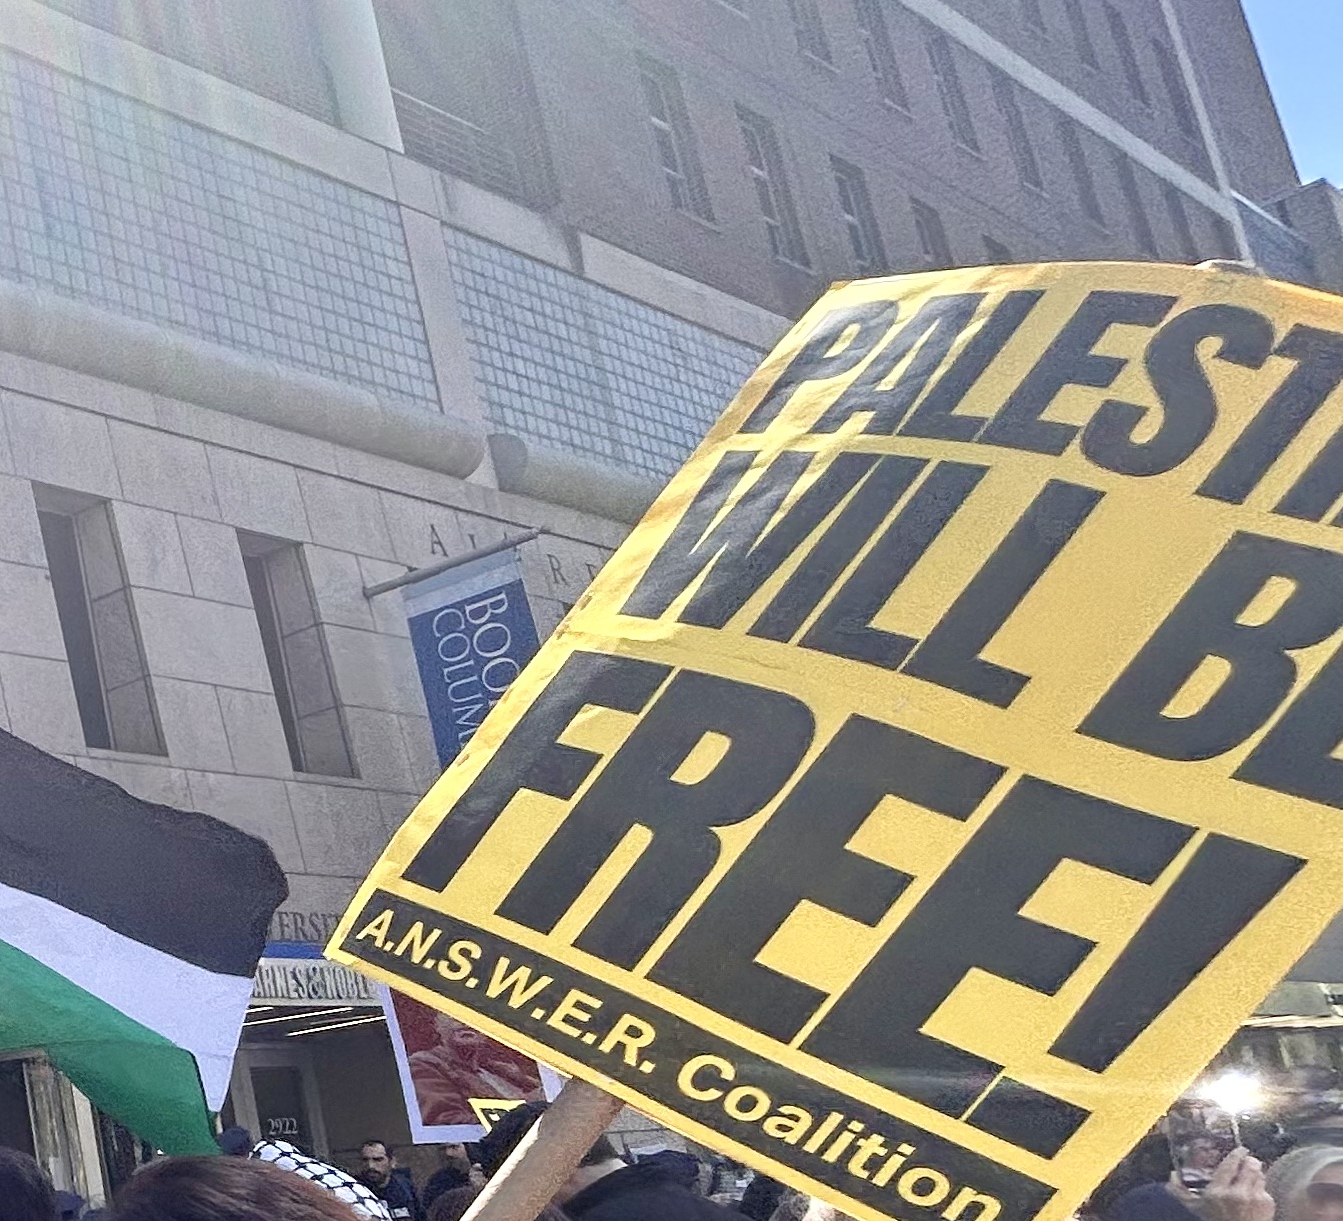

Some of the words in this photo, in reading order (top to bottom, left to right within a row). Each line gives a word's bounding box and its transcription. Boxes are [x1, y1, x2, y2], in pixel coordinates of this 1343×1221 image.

[432, 607, 487, 741] COLUM
[617, 450, 1107, 710] WILL
[357, 908, 657, 1074] A.N.S.W.E.R.
[403, 649, 1309, 1162] FREE!
